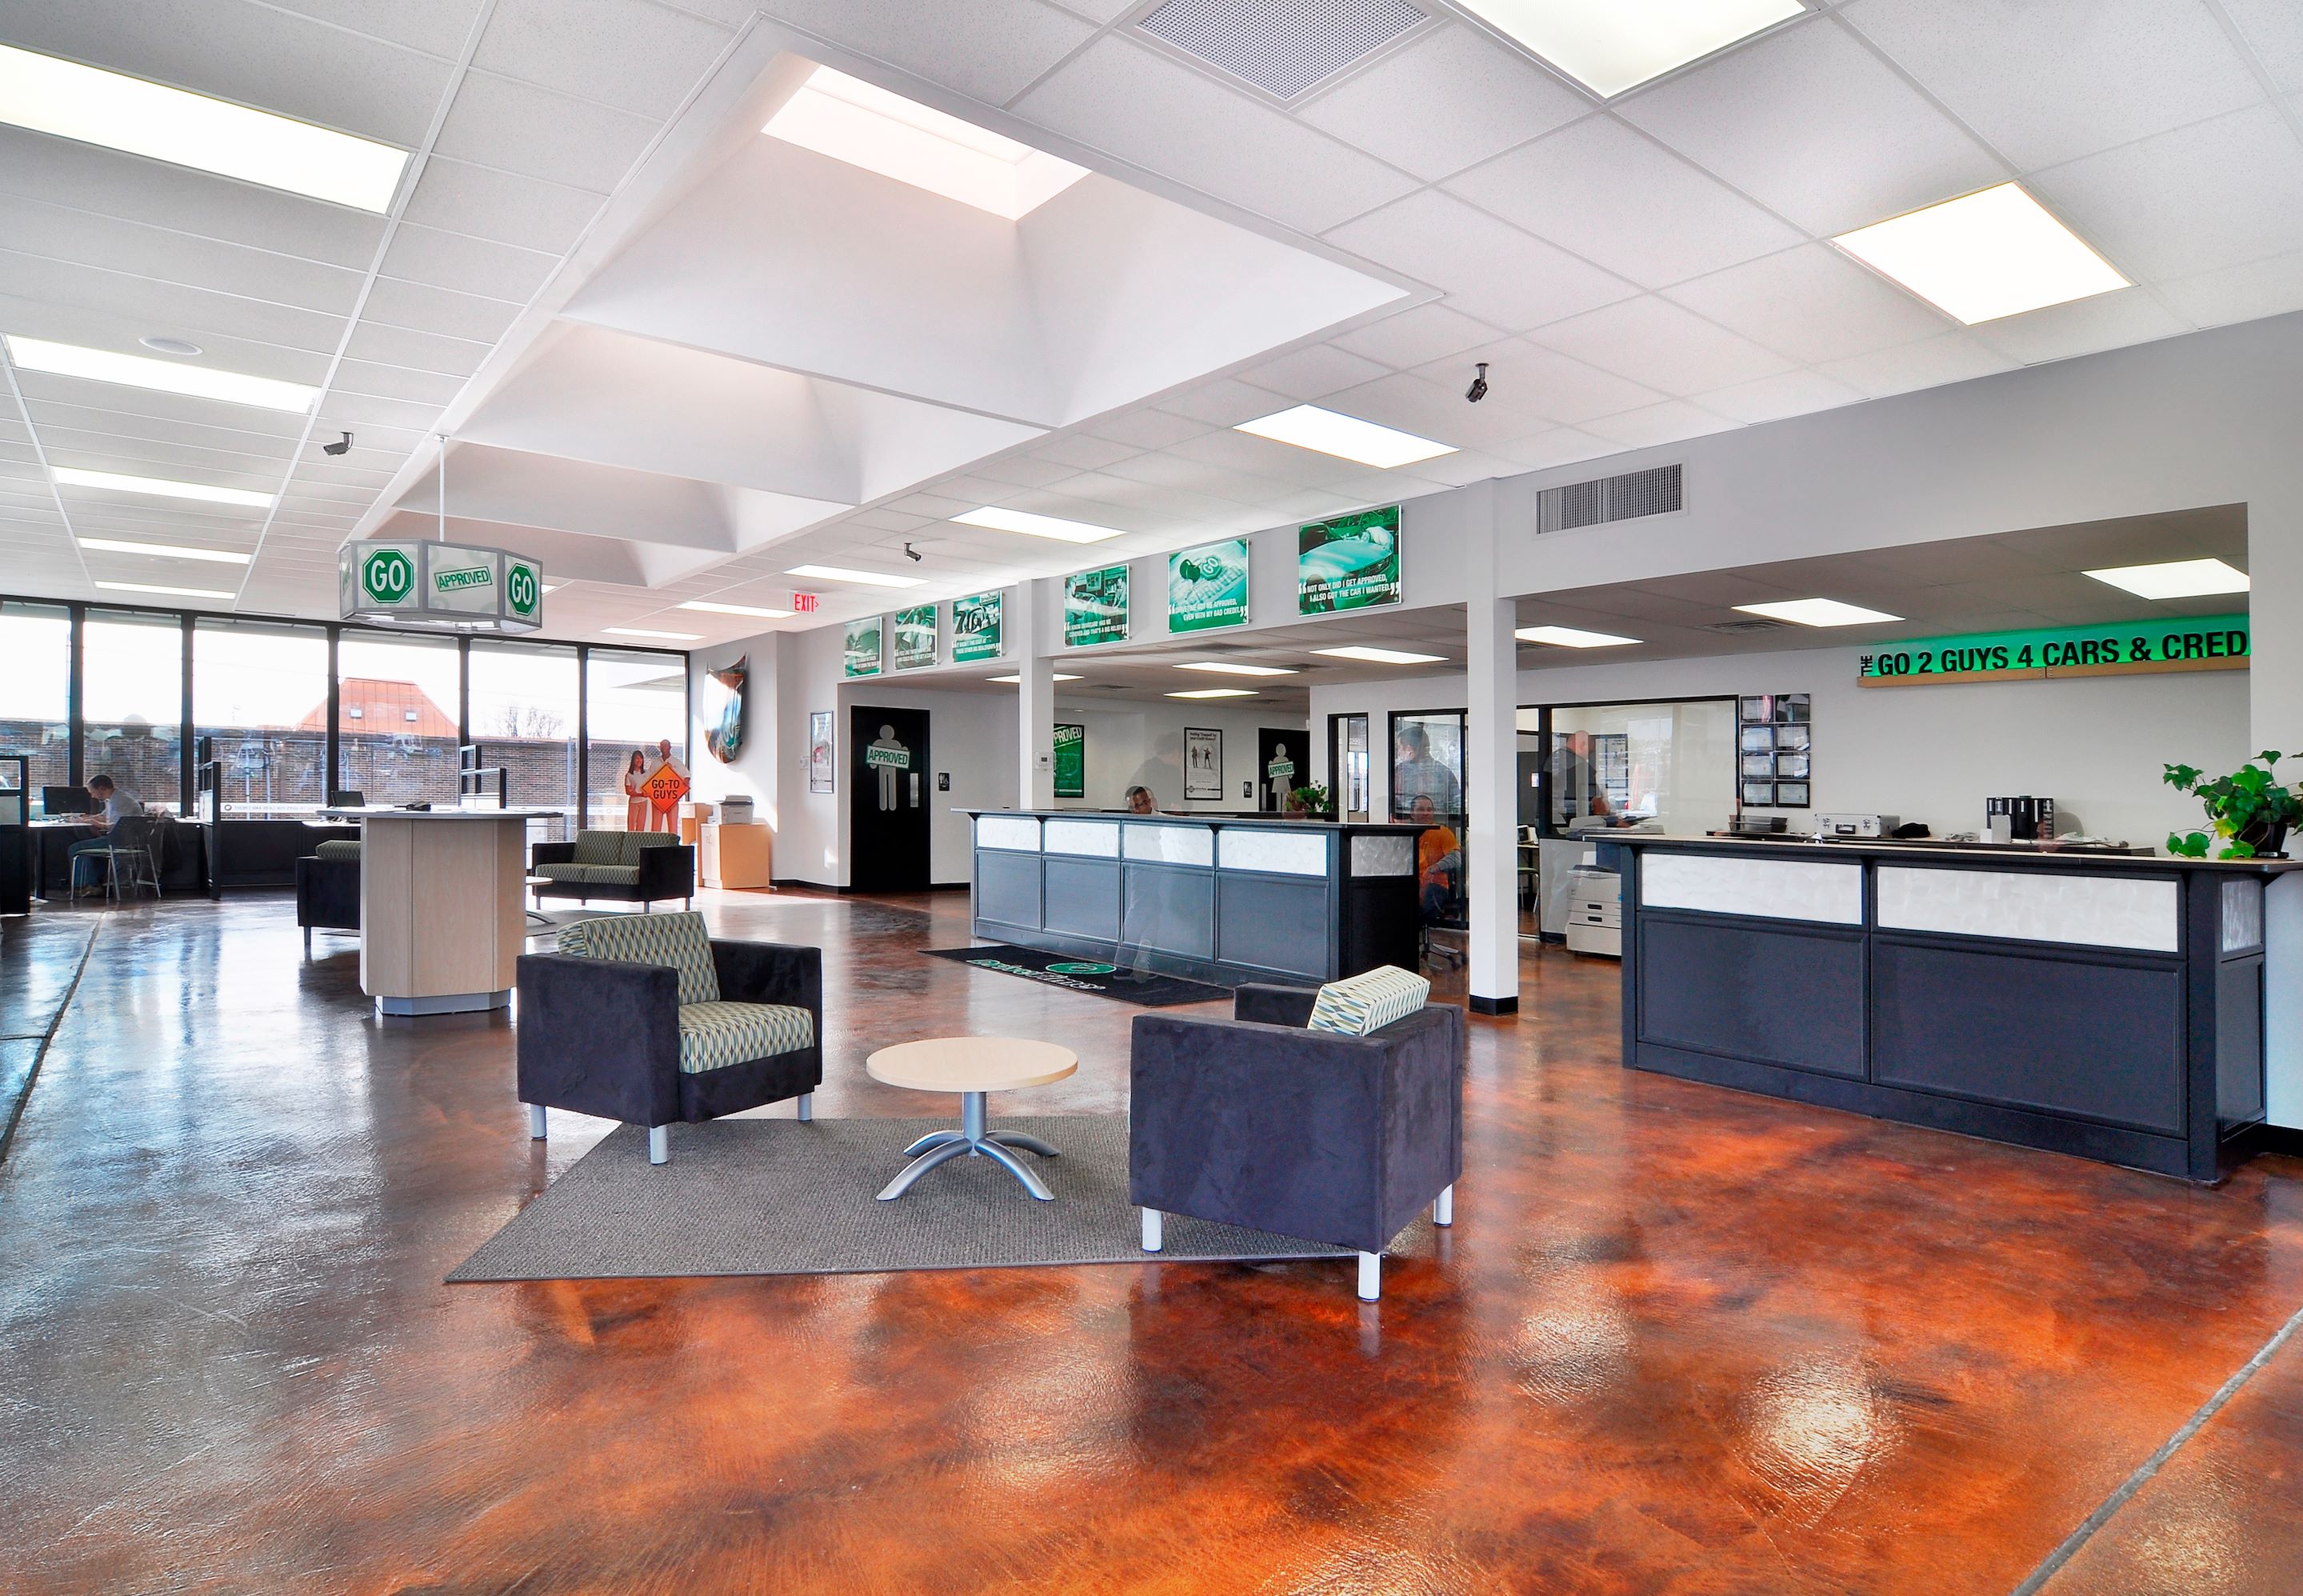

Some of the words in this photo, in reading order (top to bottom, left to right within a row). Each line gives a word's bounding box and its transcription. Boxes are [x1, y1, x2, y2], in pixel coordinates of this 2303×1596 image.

[1202, 558, 1218, 574] GO
[371, 560, 406, 592] GO
[439, 570, 490, 588] APPROVED
[1318, 582, 1332, 592] ONLY
[1333, 581, 1341, 589] DID
[1346, 578, 1357, 586] GET
[1357, 574, 1387, 585] APPROVED,
[511, 573, 533, 606] GO
[1313, 593, 1326, 602] ALSO
[1327, 591, 1337, 600] GOT
[1339, 590, 1349, 598] THE
[1350, 587, 1361, 596] CAR
[794, 594, 815, 612] EXIT
[1213, 609, 1222, 617] BAD
[1861, 655, 1873, 676] THE
[1877, 653, 1910, 677] GO
[1917, 652, 1933, 674] 2
[1941, 646, 2009, 672] GUYS
[2017, 645, 2033, 667] 4
[2042, 638, 2120, 666] CARS
[2129, 637, 2152, 661] &
[2162, 630, 2247, 660] CRED
[869, 750, 908, 765] APPROVED
[1269, 763, 1293, 775] APPROVED
[652, 779, 680, 789] GO-TO
[654, 790, 678, 799] GUYS
